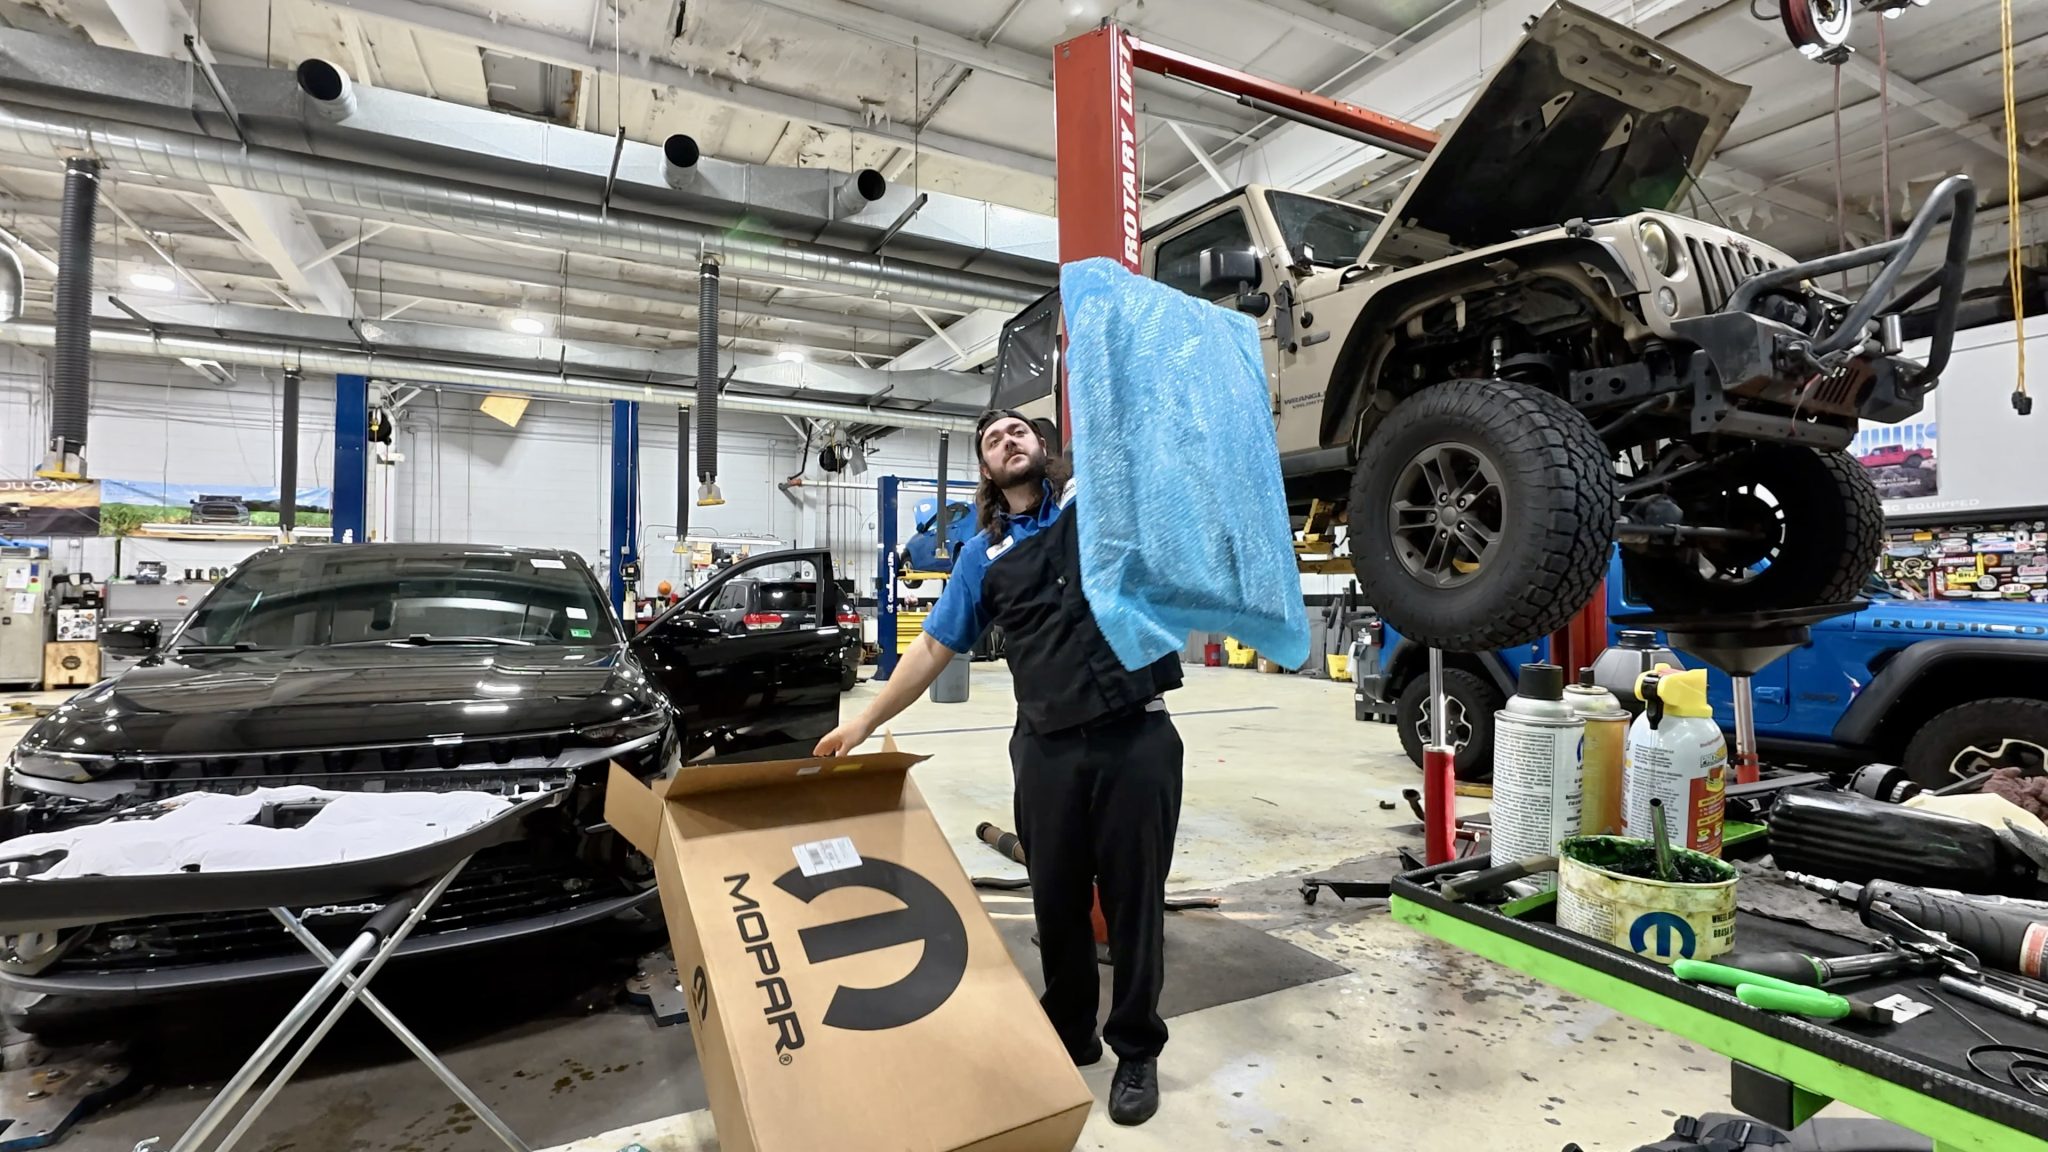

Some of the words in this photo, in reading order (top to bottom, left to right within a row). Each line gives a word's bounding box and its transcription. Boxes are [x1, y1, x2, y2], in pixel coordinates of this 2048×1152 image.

[1119, 35, 1134, 117] LIFT
[1121, 118, 1139, 265] ROTARY
[0, 481, 26, 491] OU
[31, 480, 78, 492] CAN
[1907, 498, 1980, 511] EQUIPPED
[1872, 618, 2046, 635] RUBICO
[723, 872, 805, 1055] MOPAR
